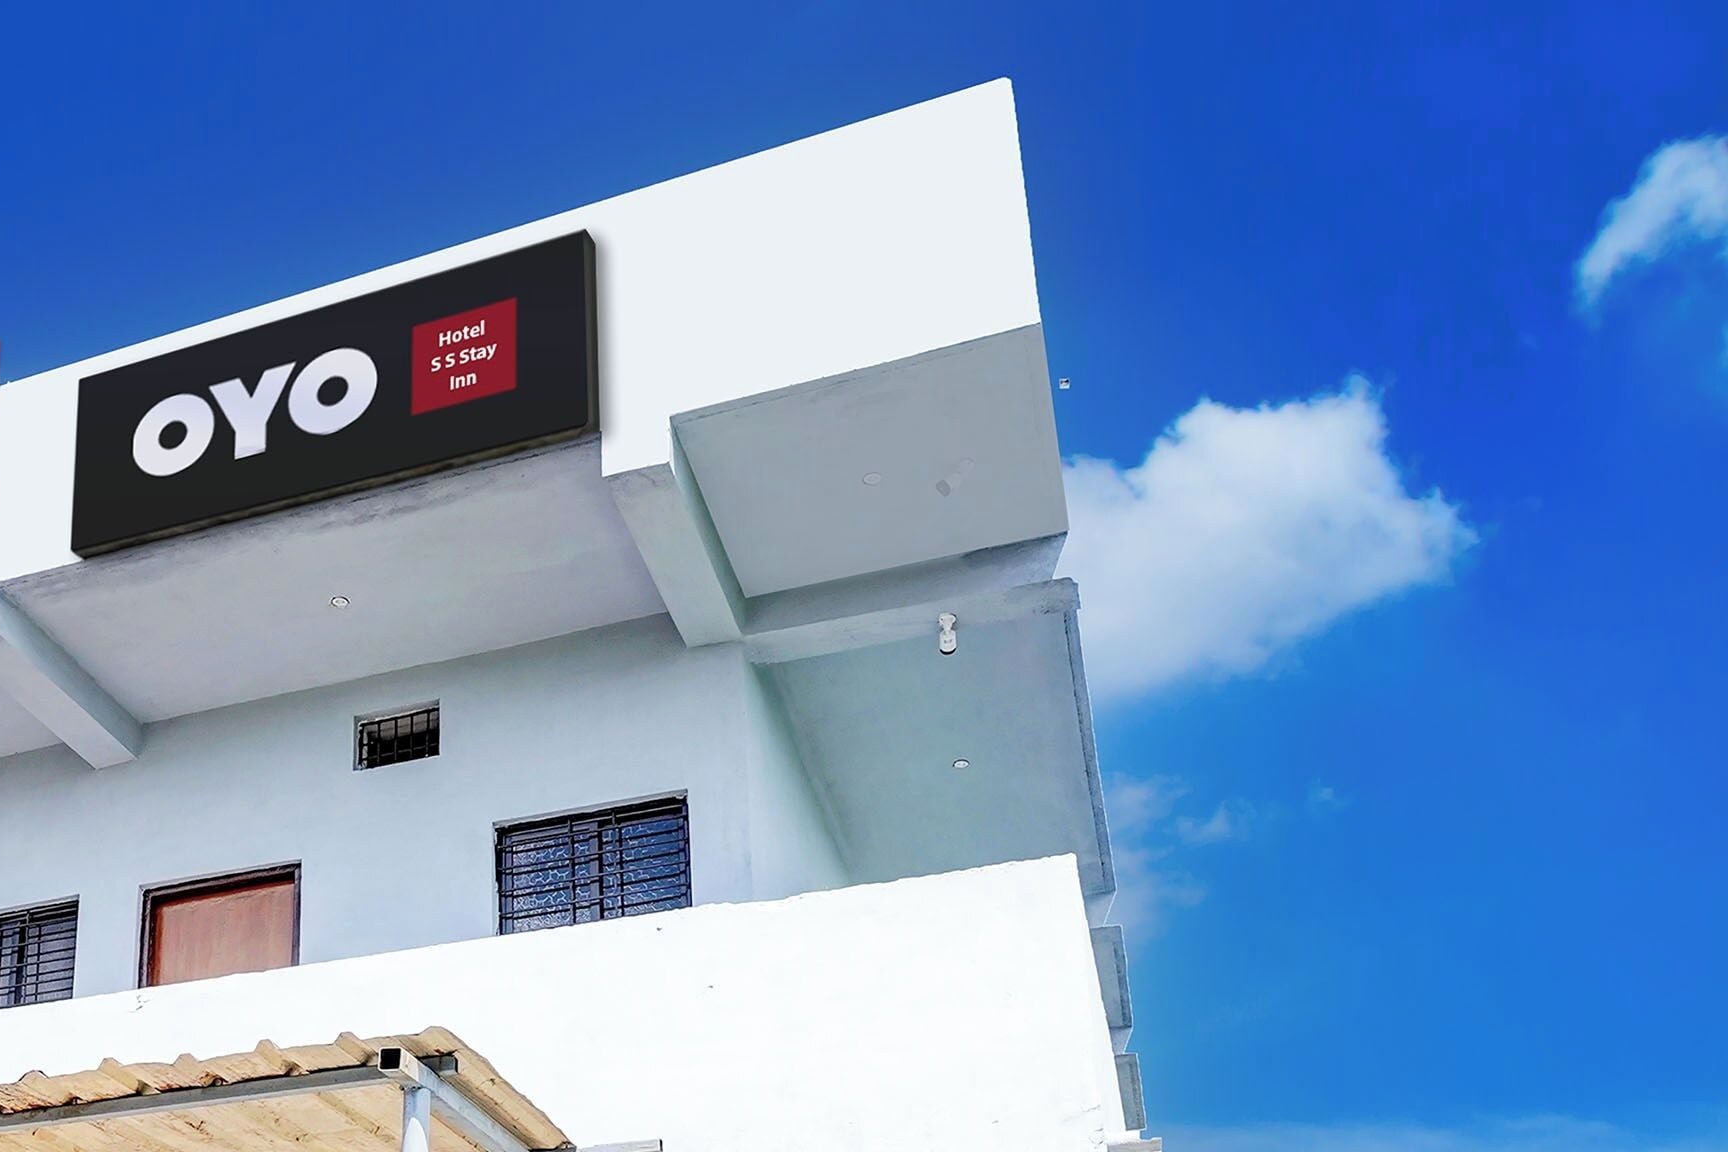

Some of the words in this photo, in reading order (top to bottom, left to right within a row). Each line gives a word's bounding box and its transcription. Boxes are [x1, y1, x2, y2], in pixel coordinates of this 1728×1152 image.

[438, 319, 485, 347] Hotel
[431, 356, 442, 372] S
[444, 353, 456, 369] S
[459, 343, 497, 365] Stay
[450, 372, 477, 391] Inn
[132, 347, 378, 477] OYO
